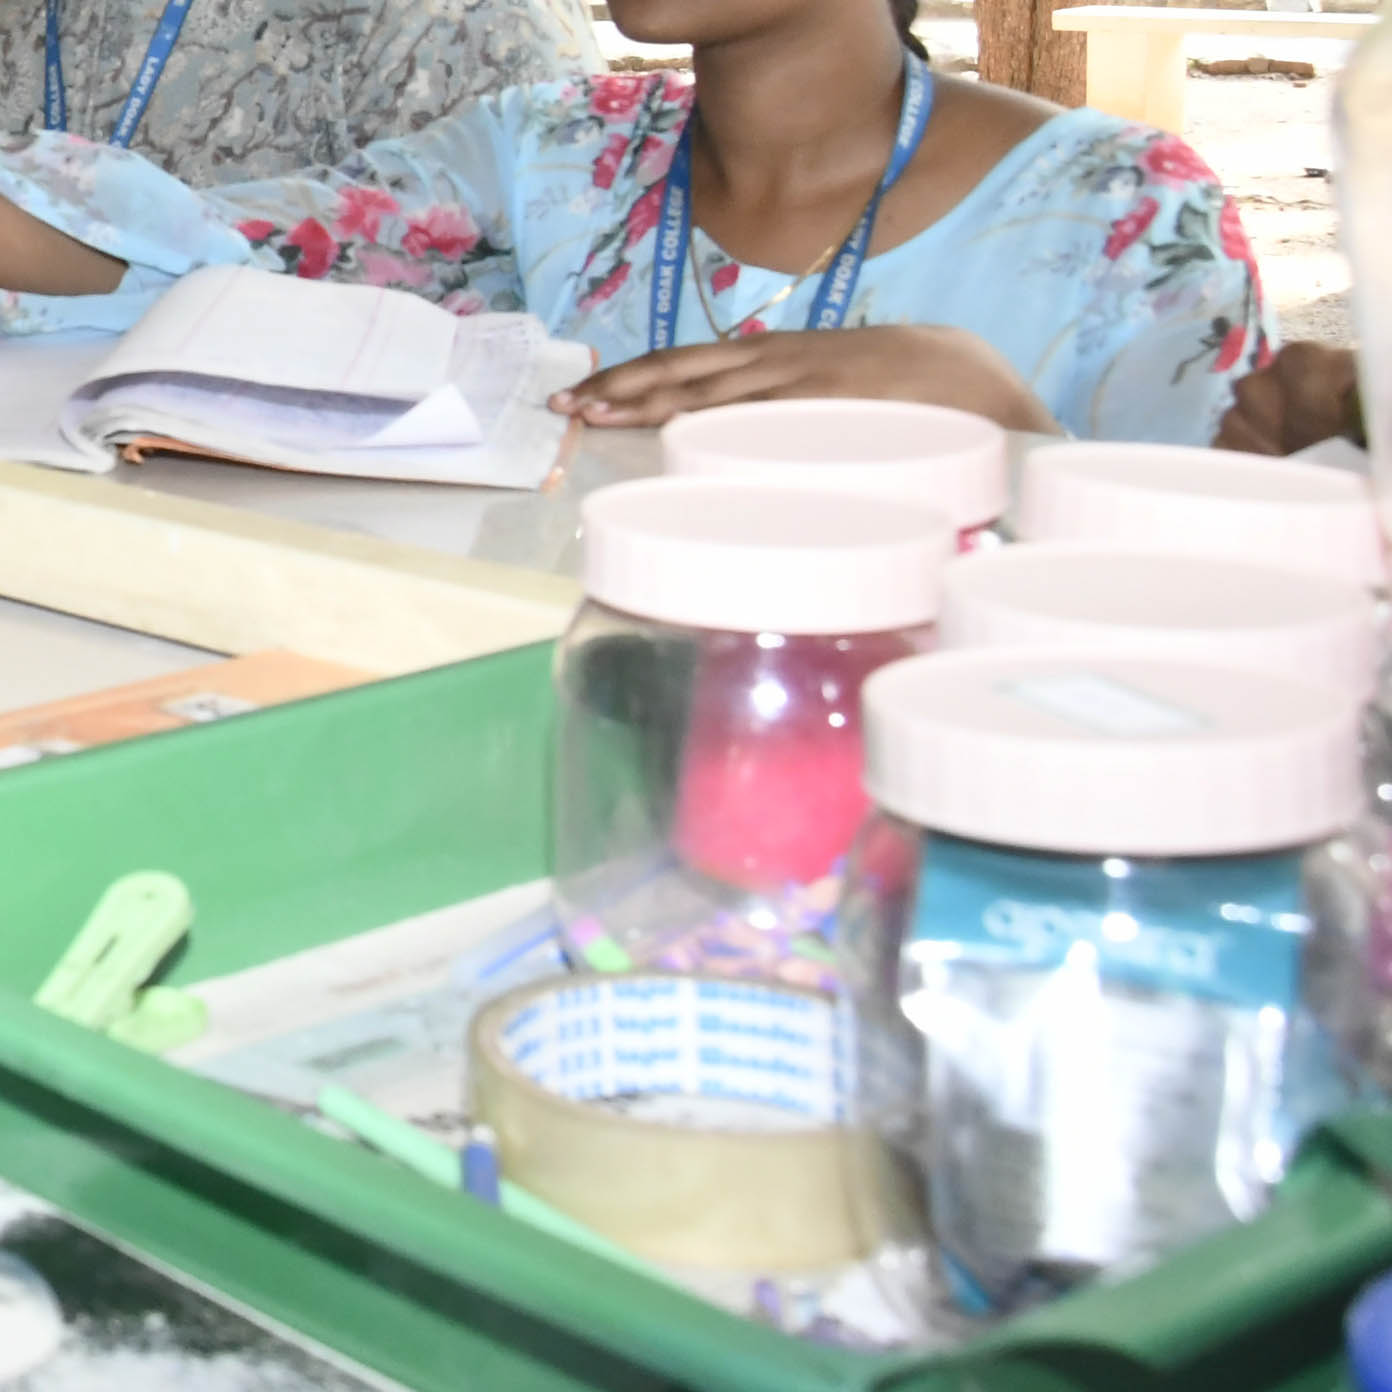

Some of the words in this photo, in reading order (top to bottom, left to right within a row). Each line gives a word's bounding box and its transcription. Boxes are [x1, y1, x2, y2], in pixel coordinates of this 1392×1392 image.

[136, 56, 160, 96] LADY
[661, 186, 684, 261] COLLEGE
[657, 264, 675, 313] DOAK
[826, 253, 856, 305] DOAK
[655, 318, 669, 349] ADY
